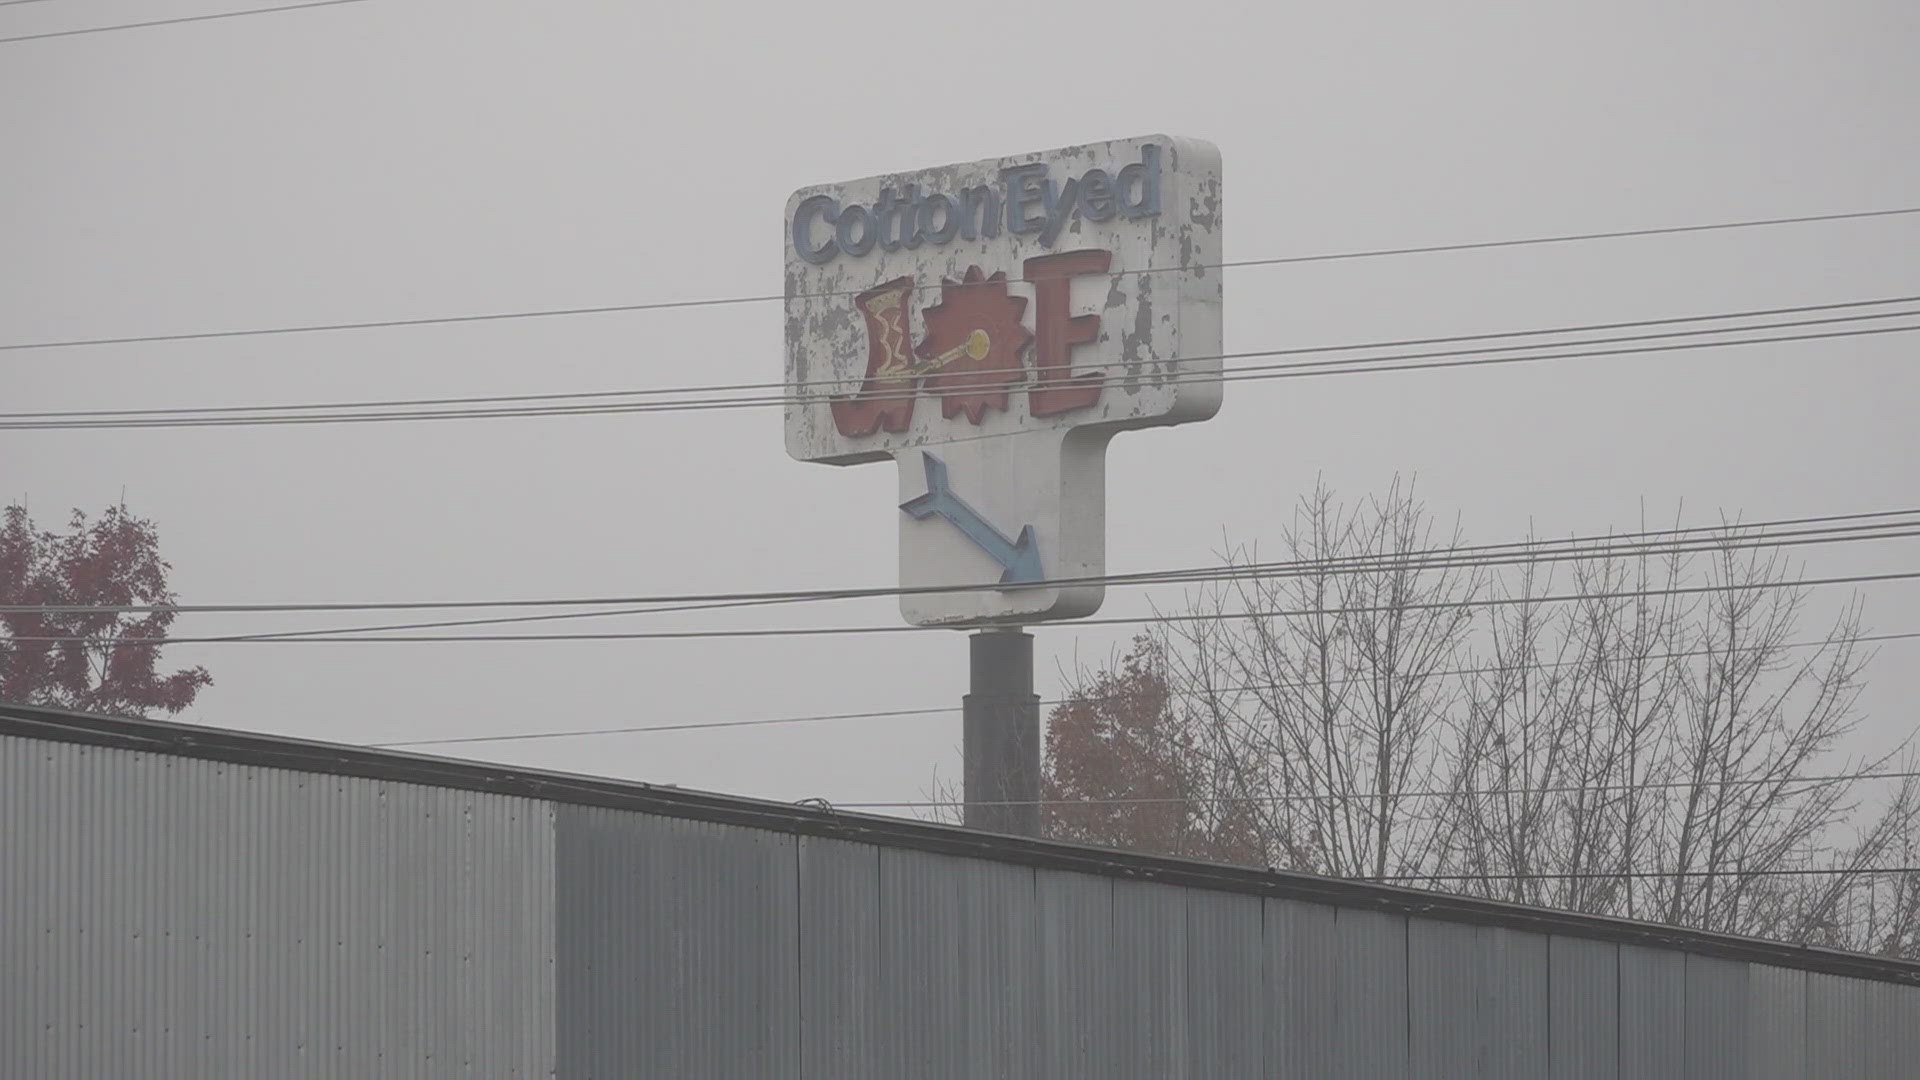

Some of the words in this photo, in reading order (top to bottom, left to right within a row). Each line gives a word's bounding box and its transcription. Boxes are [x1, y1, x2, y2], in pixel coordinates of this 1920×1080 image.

[793, 183, 998, 265] Cotton
[1001, 143, 1161, 248] Eyed
[829, 249, 1112, 438] JOE
